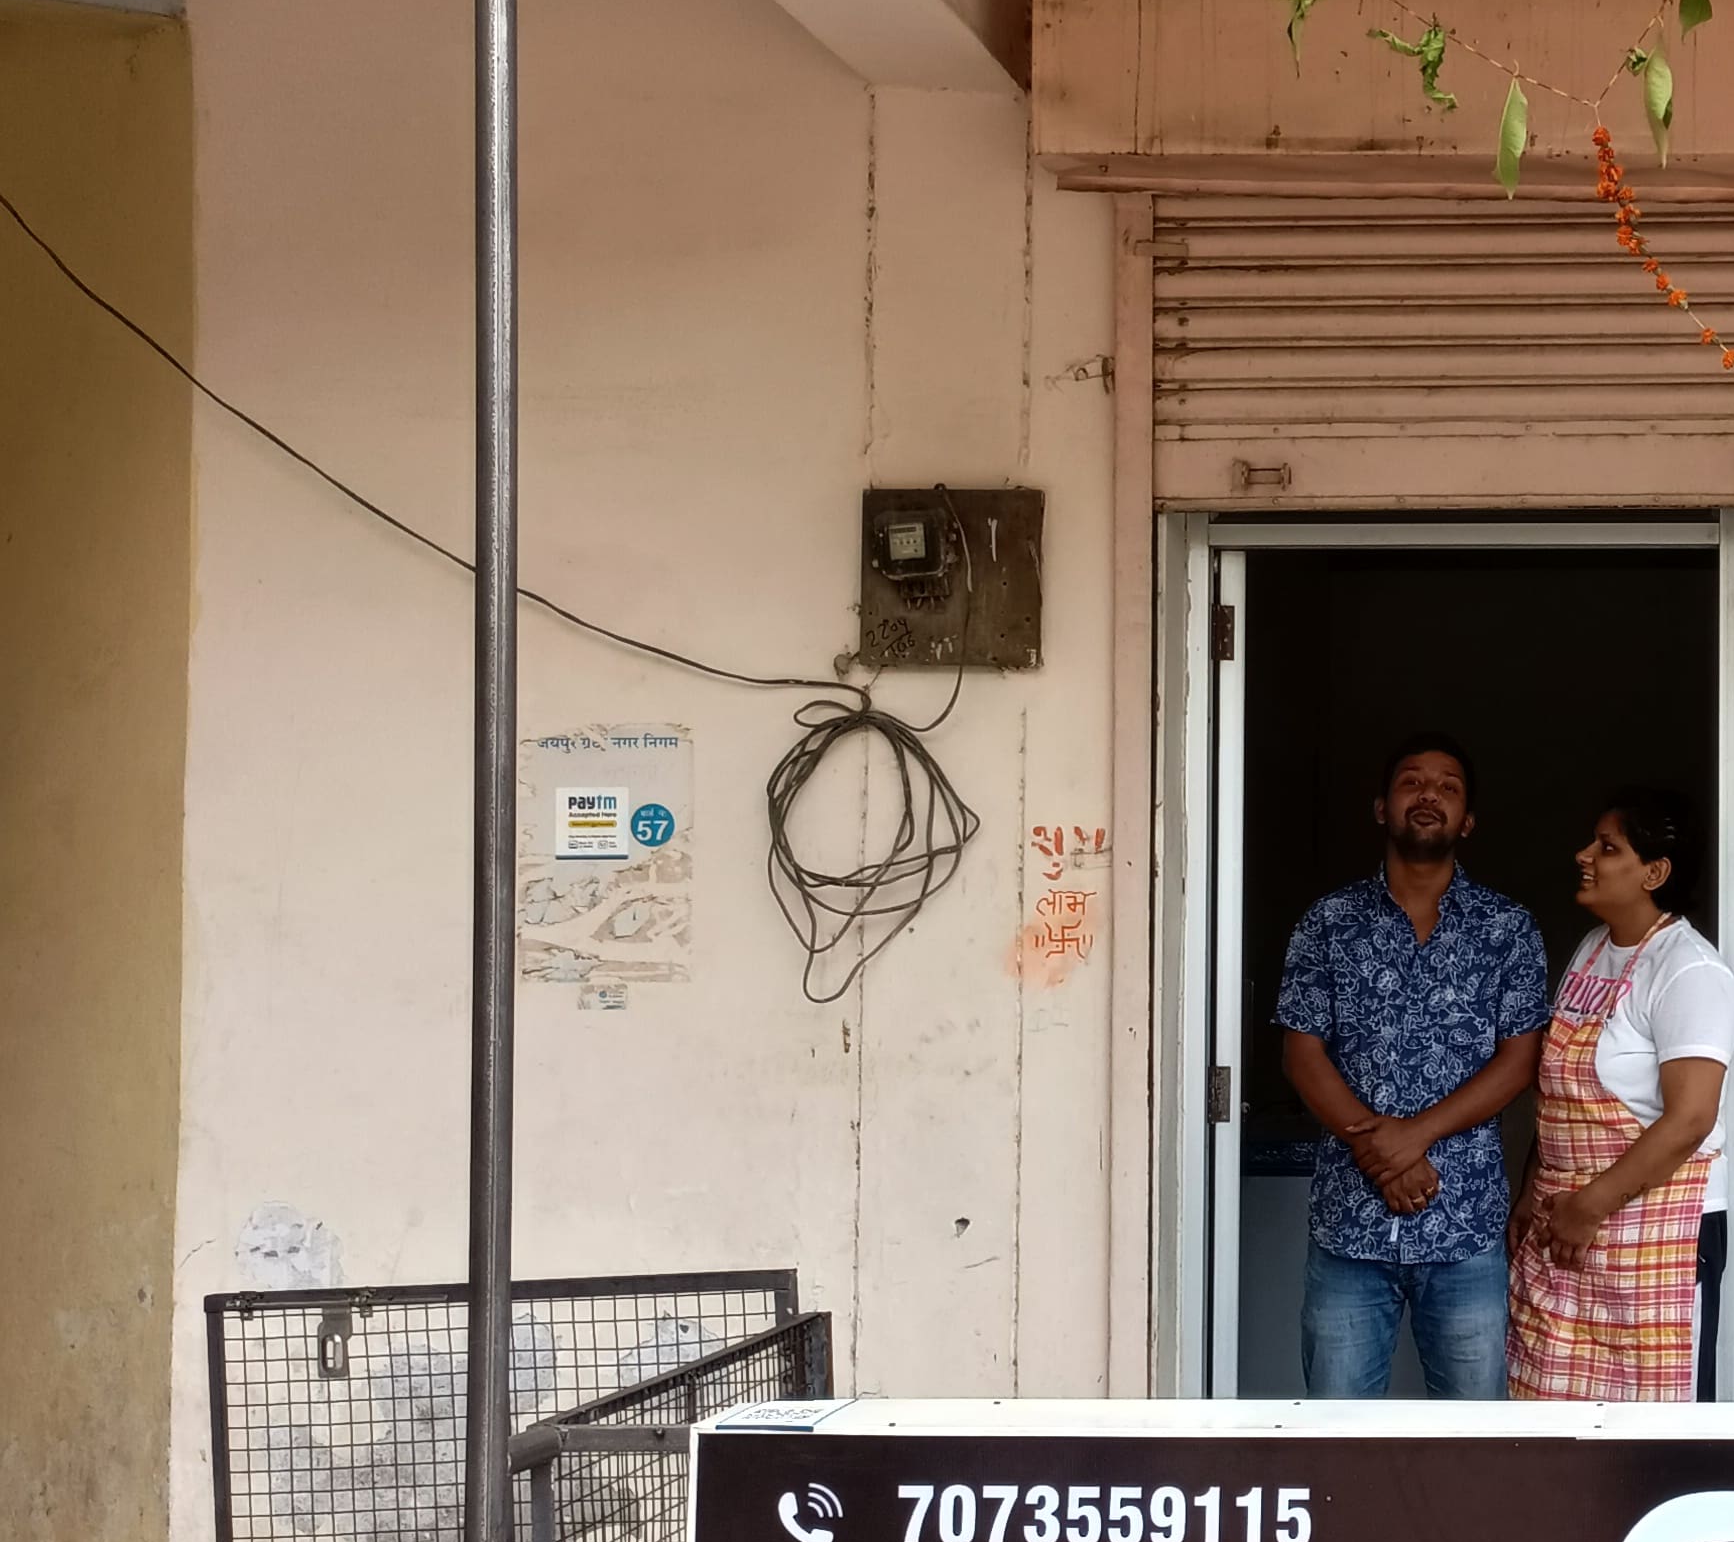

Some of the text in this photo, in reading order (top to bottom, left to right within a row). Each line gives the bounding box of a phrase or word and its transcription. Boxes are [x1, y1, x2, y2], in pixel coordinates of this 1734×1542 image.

[611, 736, 639, 749] नगर
[643, 732, 679, 749] निगम
[636, 820, 669, 841] 57
